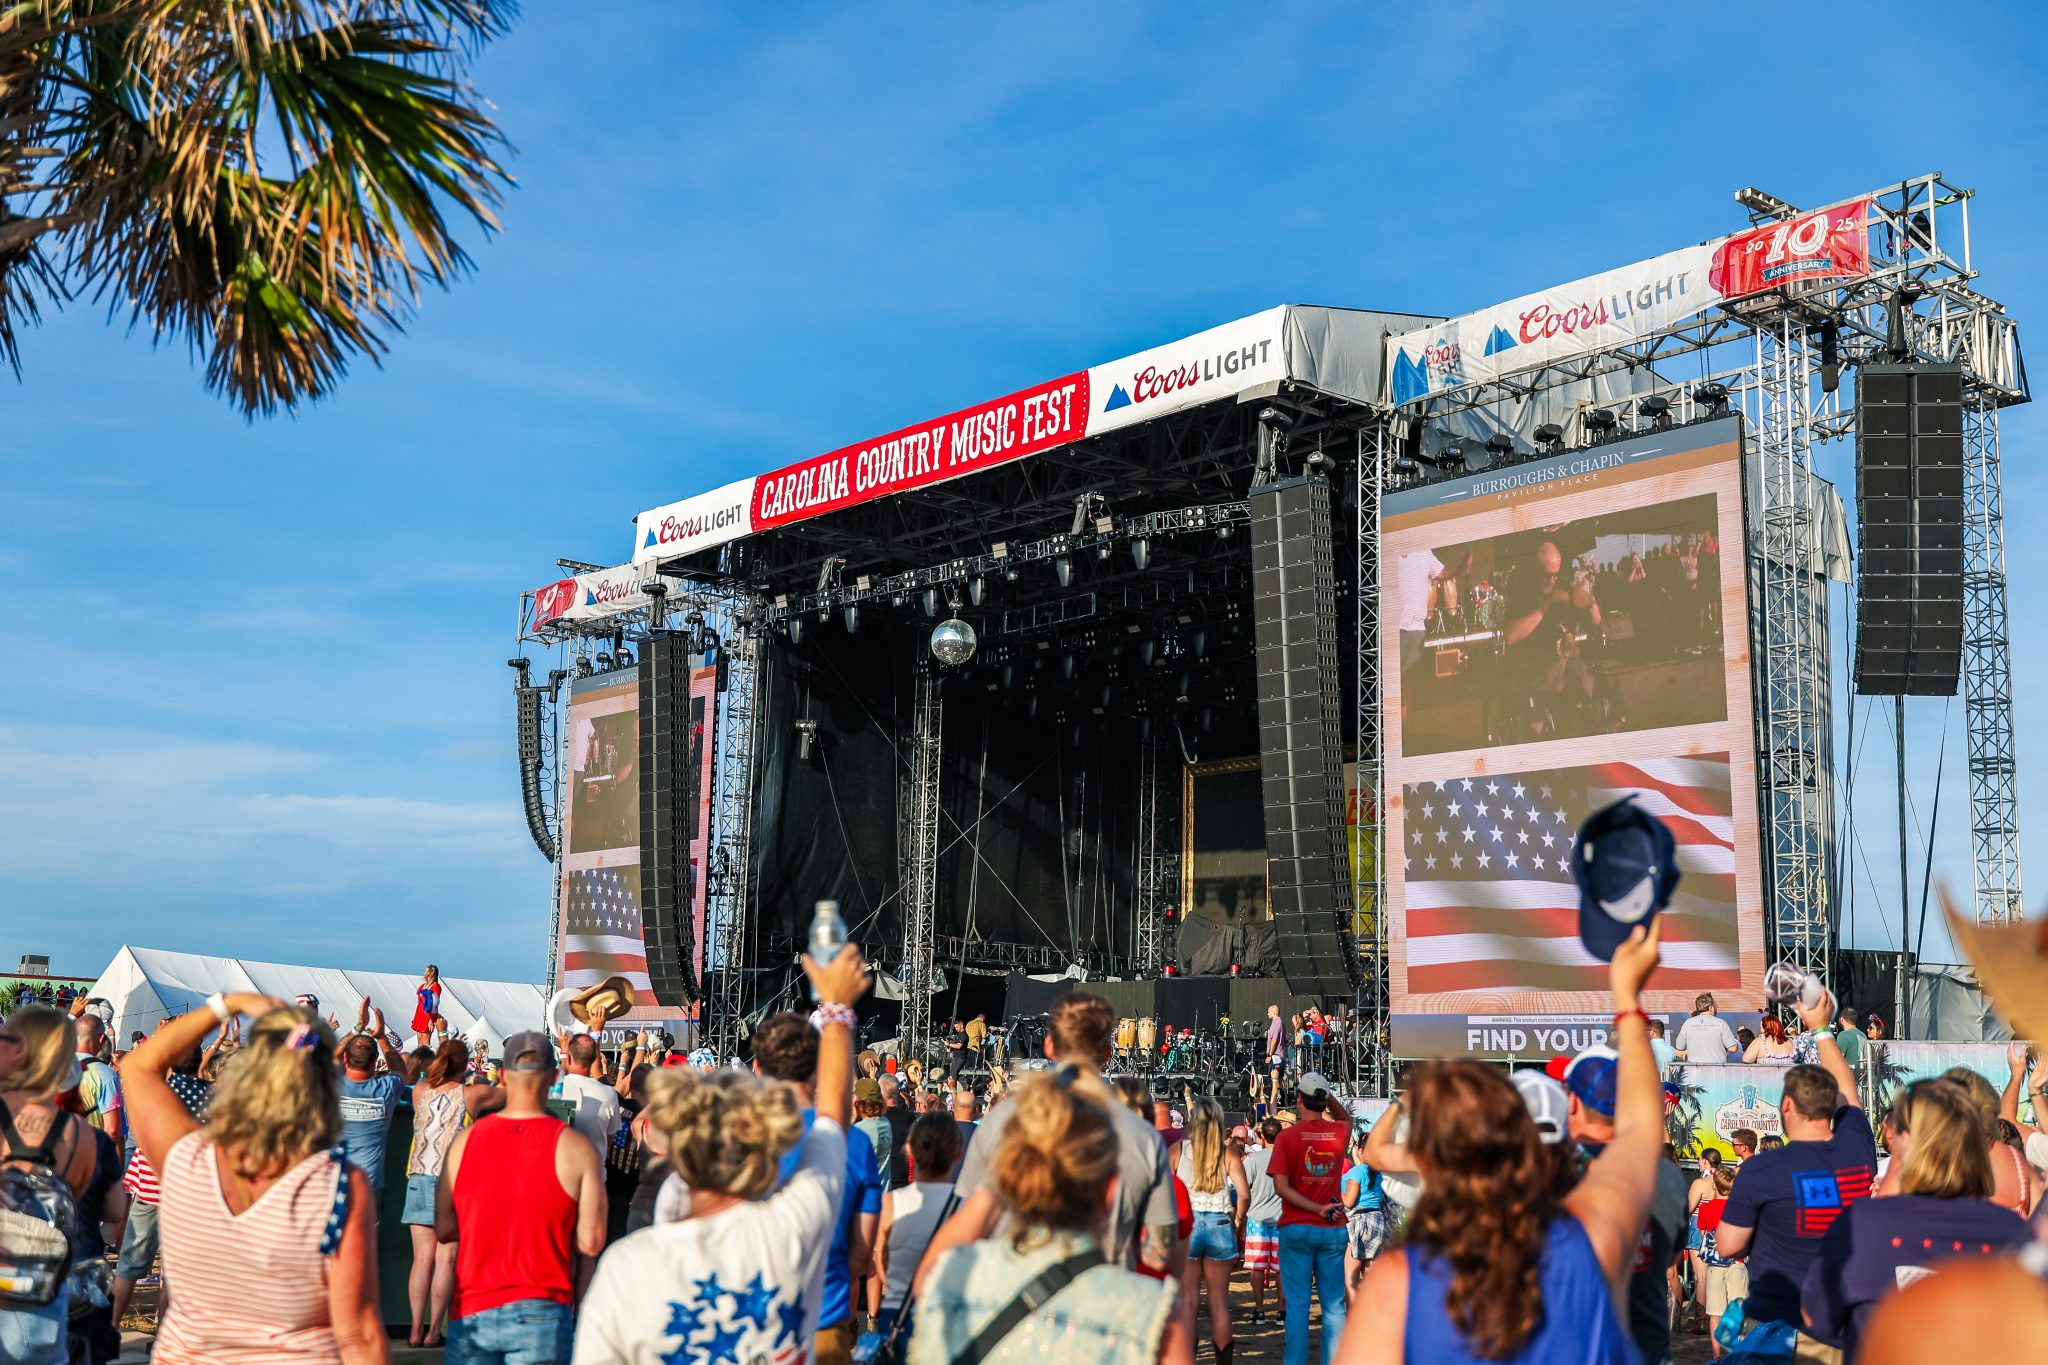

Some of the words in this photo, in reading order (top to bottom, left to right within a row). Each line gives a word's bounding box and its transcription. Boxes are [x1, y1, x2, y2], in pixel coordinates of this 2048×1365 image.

[1765, 214, 1829, 264] 10
[1769, 260, 1825, 278] ANNIVERSARY
[1518, 297, 1609, 345] Coors
[1611, 270, 1692, 321] LIGHT
[1133, 359, 1201, 404] Coors
[1203, 338, 1272, 382] LIGHT
[760, 456, 849, 520] CAROLINA
[855, 425, 947, 493] COUNTRY
[949, 403, 1017, 467] MUSIC
[1021, 383, 1077, 445] FEST
[1472, 467, 1555, 497] BURROUGHS
[1558, 465, 1568, 478] &
[1570, 451, 1625, 475] CHAPIN
[1497, 483, 1554, 501] PAVILION
[1560, 473, 1598, 488] PLACE
[659, 515, 703, 545] Coors
[704, 504, 742, 533] LIGHT
[596, 579, 630, 604] Coors
[1468, 1029, 1527, 1051] FIND
[1532, 1029, 1608, 1052] YOUR
[1720, 1118, 1750, 1130] CAROLINA
[1751, 1119, 1779, 1132] COUNTRY
